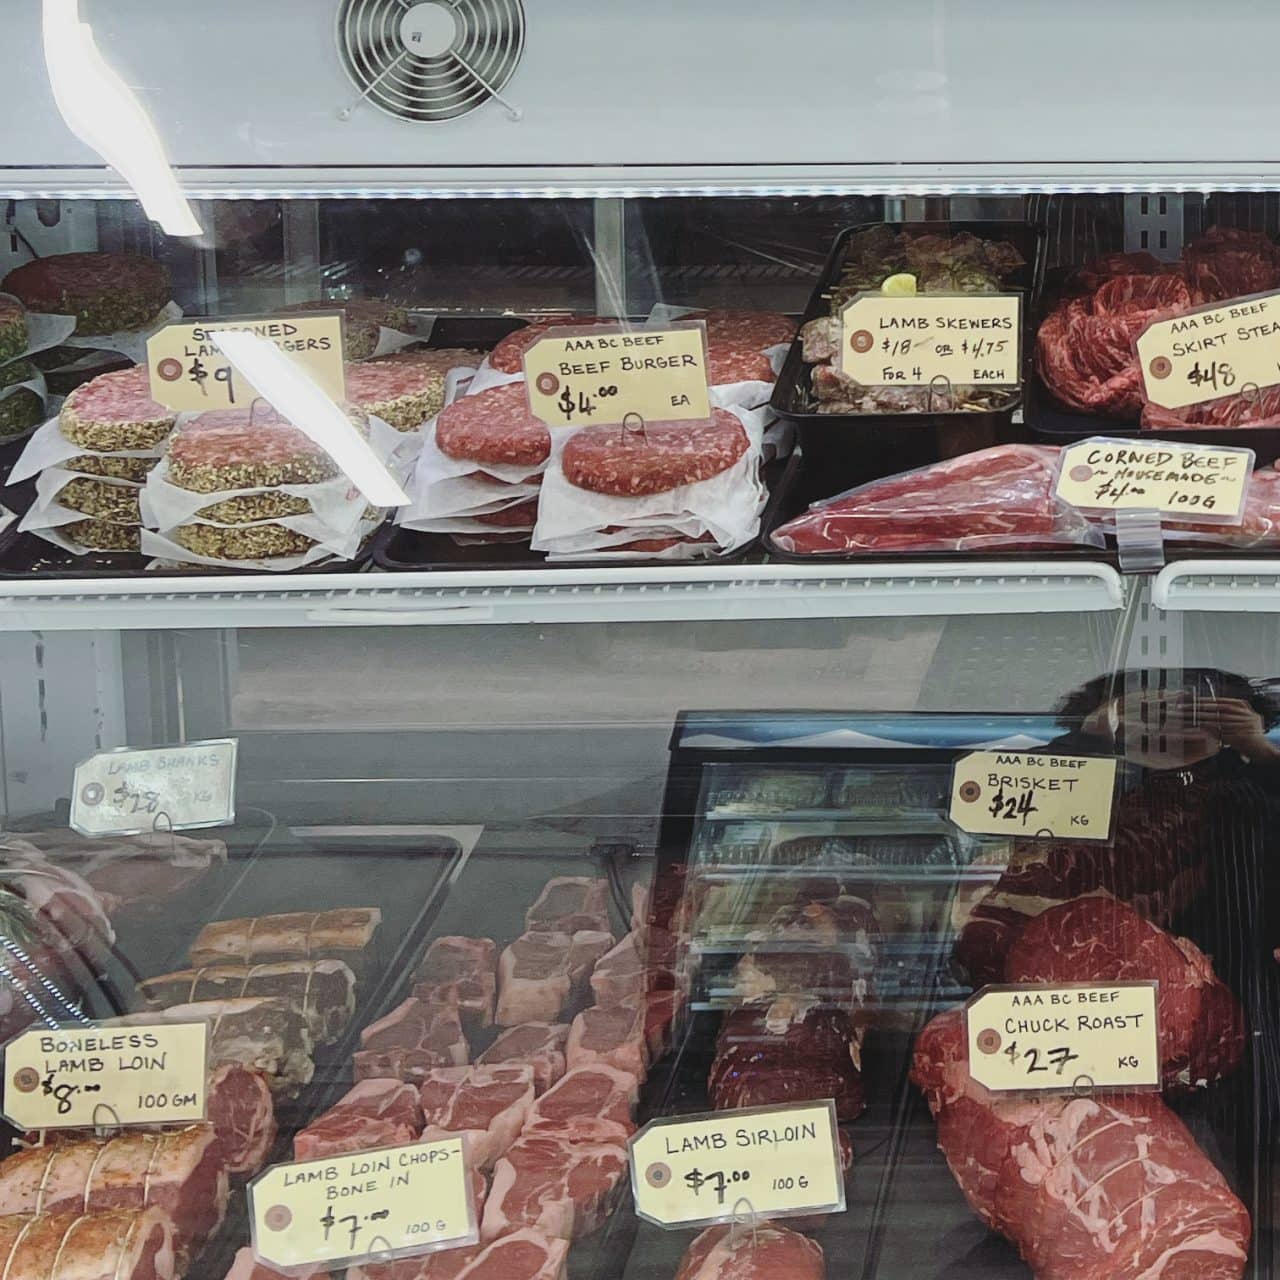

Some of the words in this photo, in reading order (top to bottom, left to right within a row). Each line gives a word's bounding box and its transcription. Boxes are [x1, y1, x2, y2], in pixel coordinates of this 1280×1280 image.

[880, 318, 929, 329] LAMB
[936, 318, 1012, 329] SKEWERS
[1171, 320, 1198, 334] AAA
[1204, 314, 1225, 325] BC
[1231, 302, 1269, 318] BEEF
[565, 341, 594, 352] AAA
[599, 339, 618, 348] BC
[623, 336, 663, 346] BEEF
[935, 344, 953, 355] OR
[1173, 334, 1227, 357] SKIRT
[559, 361, 610, 375] BEEF
[621, 355, 697, 371] BURGER
[883, 367, 906, 380] FOR
[913, 367, 921, 380] 4
[974, 369, 1004, 379] EACH
[1187, 361, 1236, 390] $48
[671, 395, 690, 406] EA
[1088, 450, 1173, 466] CORNED
[1181, 453, 1238, 469] BEEF
[996, 756, 1021, 764] AAA
[1027, 757, 1044, 766] BC
[1050, 759, 1087, 769] BEEF
[988, 774, 1079, 792] BRISKET
[989, 787, 1038, 826] $24
[1071, 816, 1089, 826] KG
[1012, 995, 1043, 1007] AAA
[1051, 994, 1071, 1005] BC
[1078, 992, 1120, 1003] BEEF
[1005, 1018, 1069, 1033] CHUCK
[1078, 1014, 1144, 1031] ROAST
[40, 1034, 158, 1052] BONELESS
[45, 1058, 104, 1074] LAMB
[119, 1052, 167, 1071] LOIN
[1004, 1041, 1079, 1075] $27
[1118, 1056, 1138, 1068] KG
[666, 1133, 727, 1154] LAMB
[736, 1122, 816, 1147] SIRLOIN
[284, 1167, 338, 1187] LAMB
[351, 1157, 391, 1176] LOIN
[327, 1181, 377, 1200] BONE
[390, 1172, 409, 1188] IN
